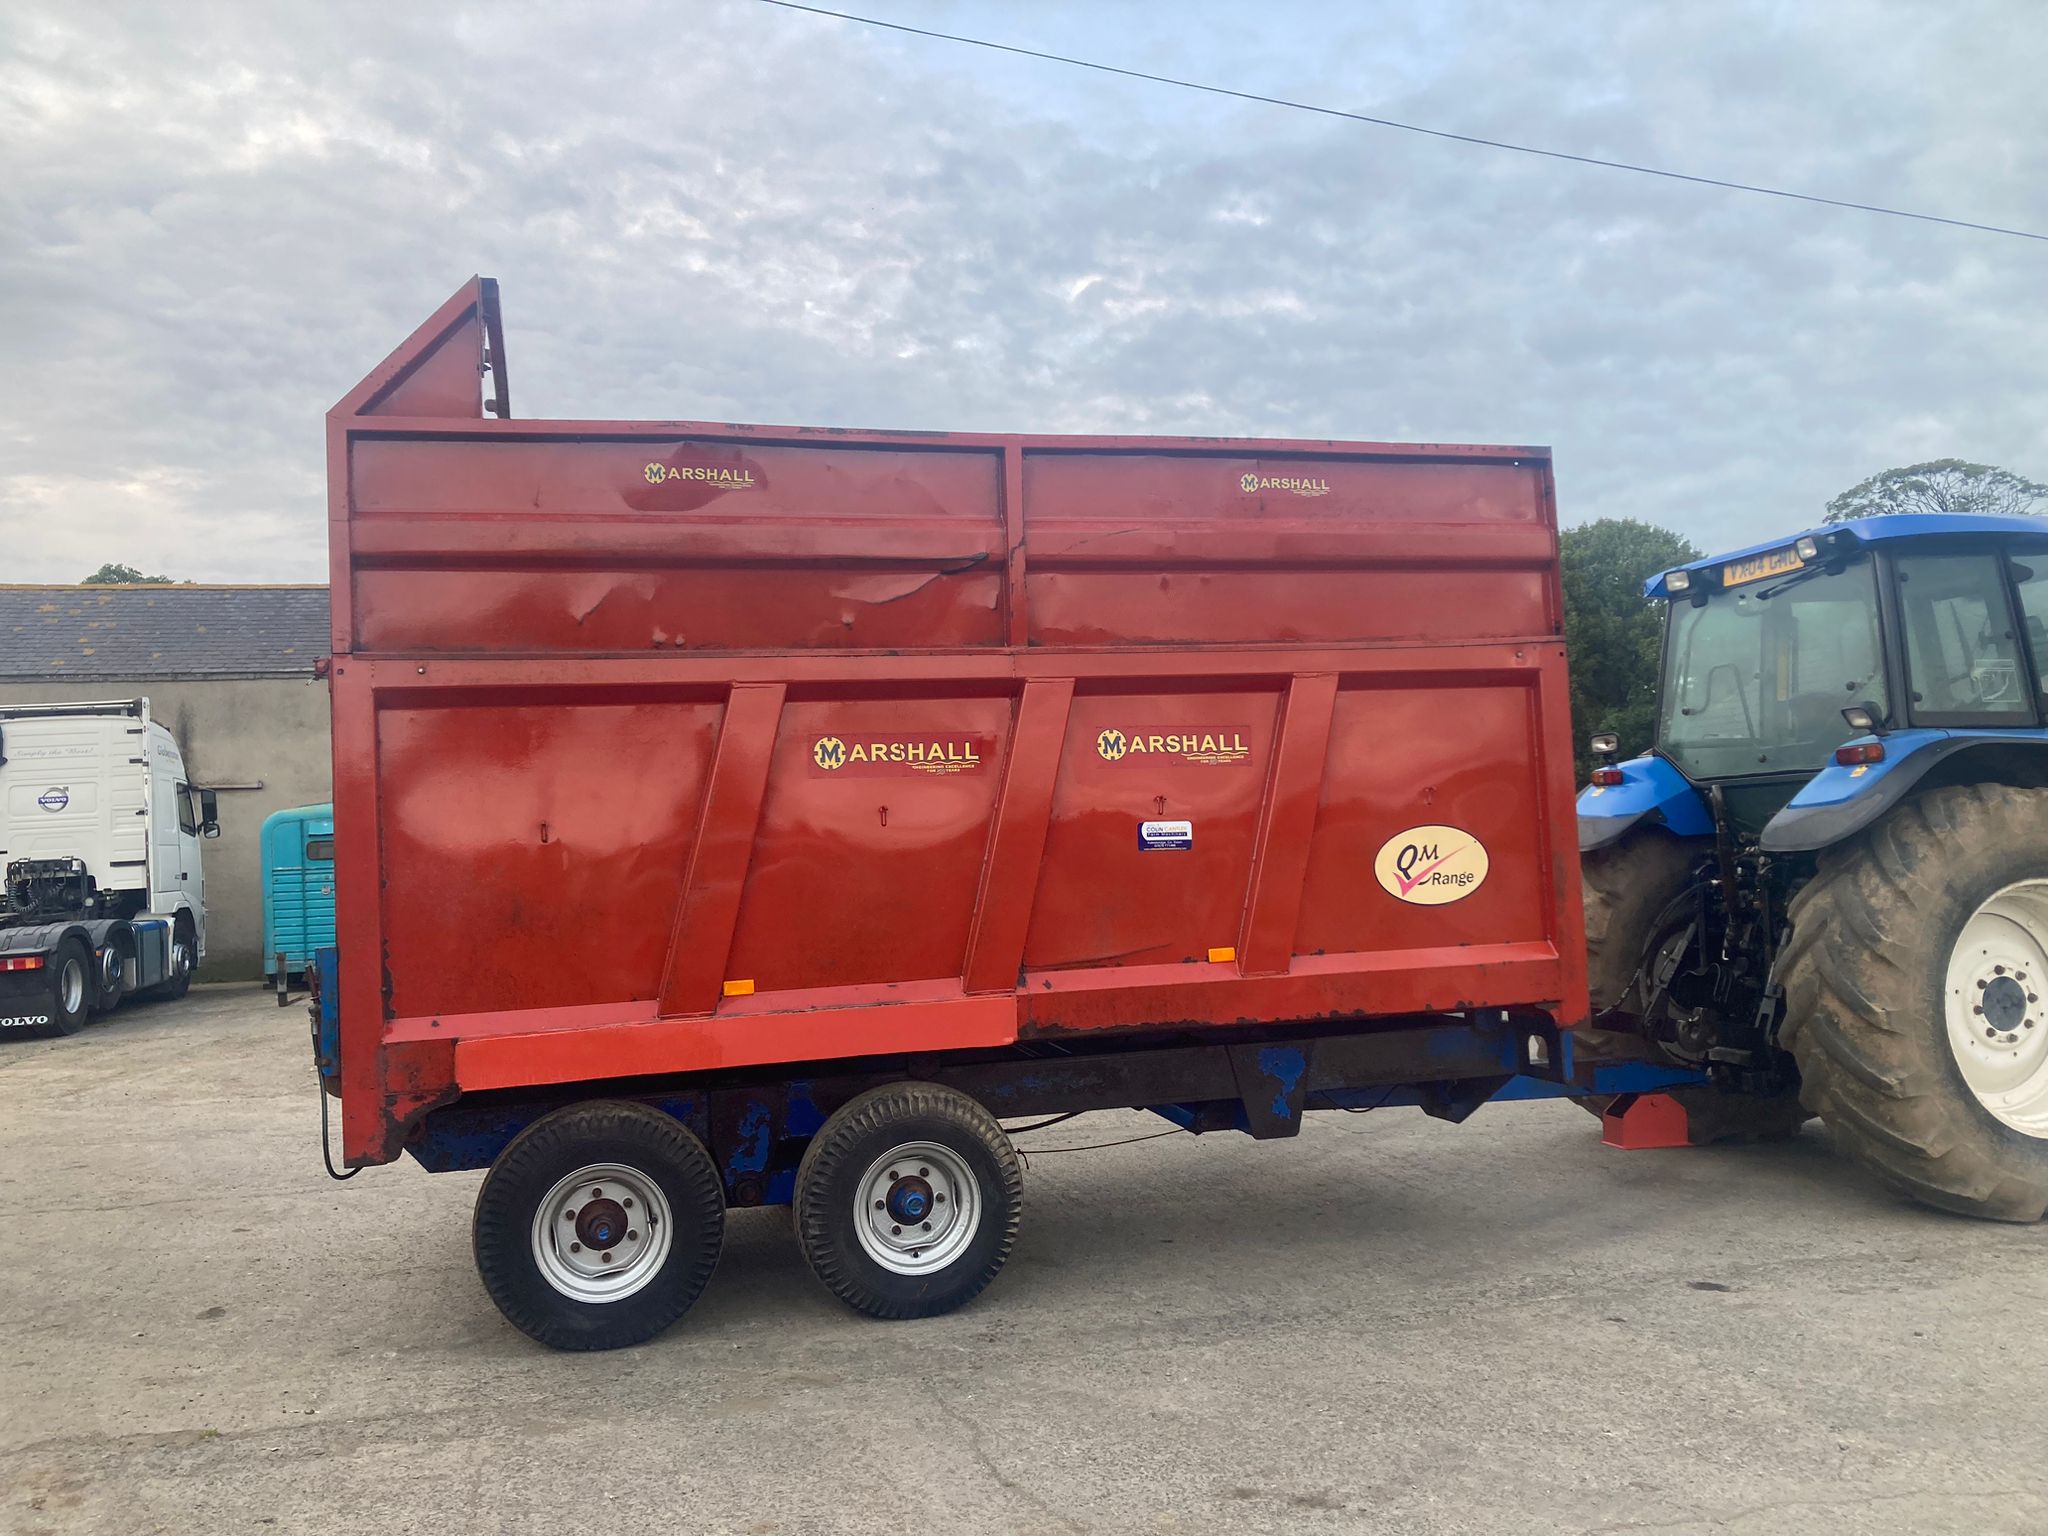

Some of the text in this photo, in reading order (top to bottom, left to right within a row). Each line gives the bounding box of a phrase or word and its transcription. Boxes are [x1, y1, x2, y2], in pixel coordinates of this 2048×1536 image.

[644, 463, 755, 484] MARSHALL
[1240, 473, 1330, 492] MARSHALL
[813, 736, 979, 769] MARSHALL
[1097, 729, 1248, 760] MARSHALL
[1396, 844, 1439, 881] QM
[1431, 871, 1474, 887] Range
[0, 1015, 48, 1027] OLVO
